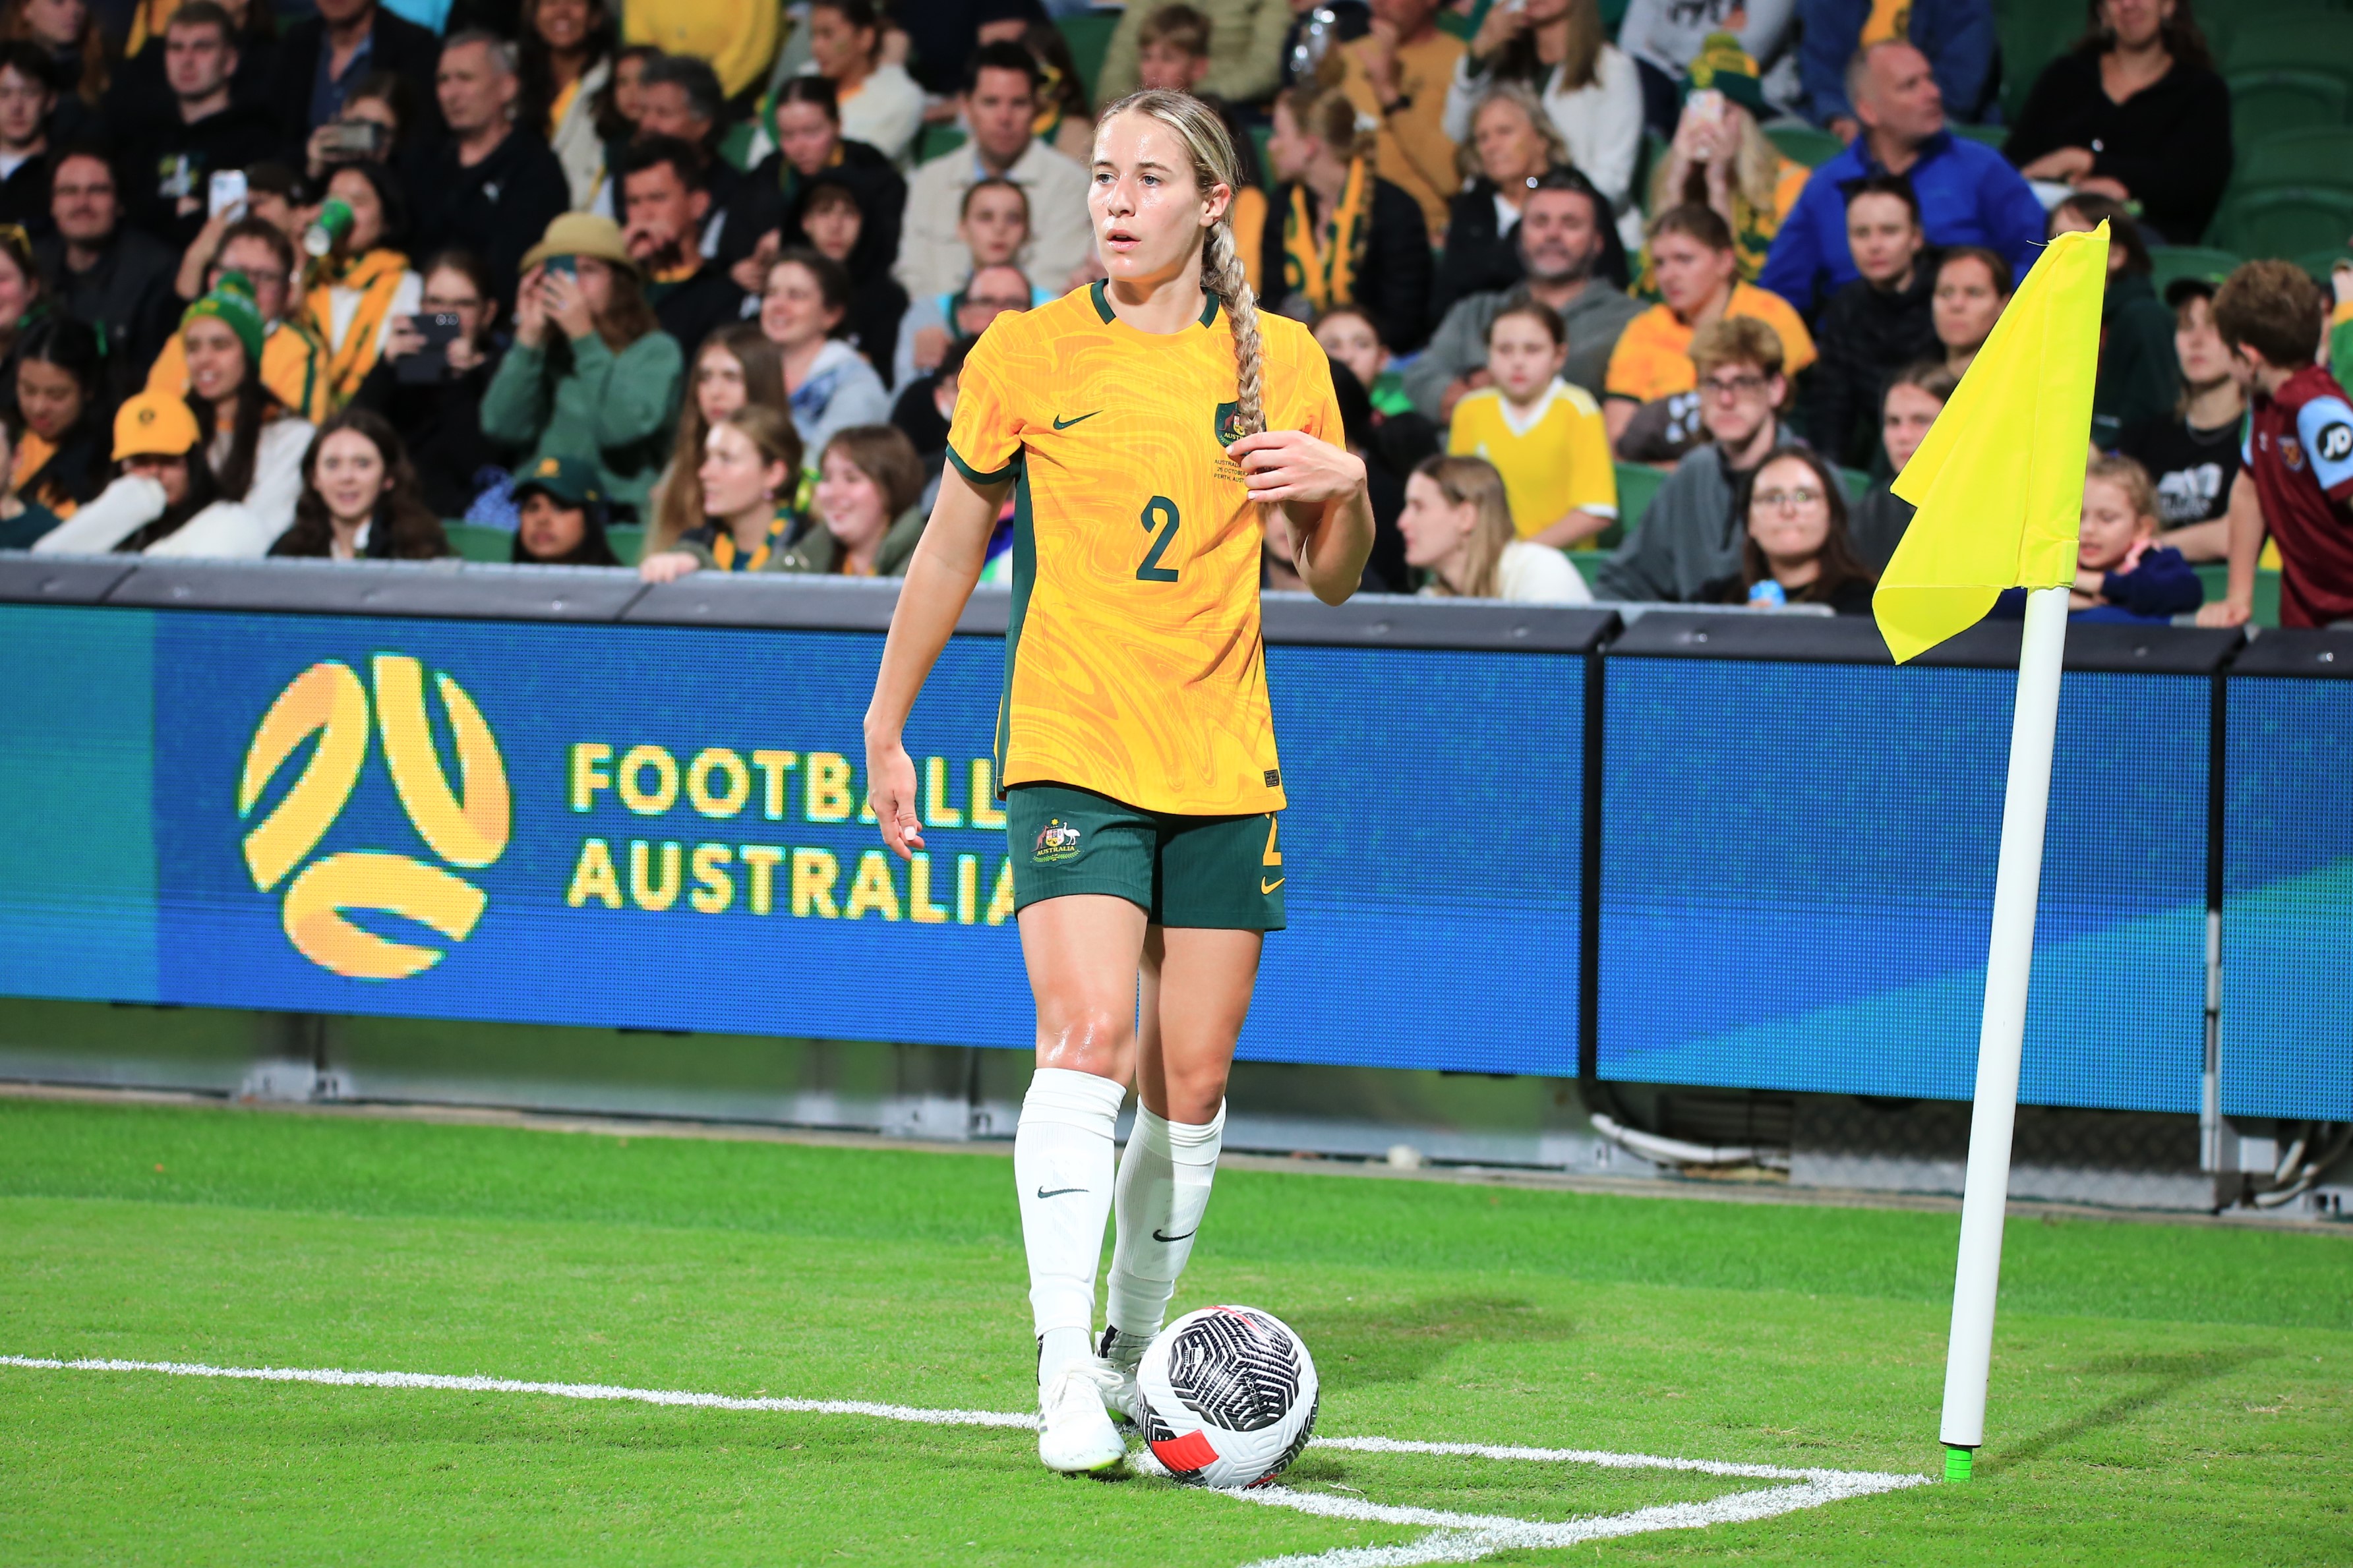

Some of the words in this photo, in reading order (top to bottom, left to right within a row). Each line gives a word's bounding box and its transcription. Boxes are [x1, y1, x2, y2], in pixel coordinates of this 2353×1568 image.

[1136, 496, 1180, 583] 2
[571, 742, 1007, 829] FOOTBLL
[1036, 846, 1075, 856] AUSTRALIA
